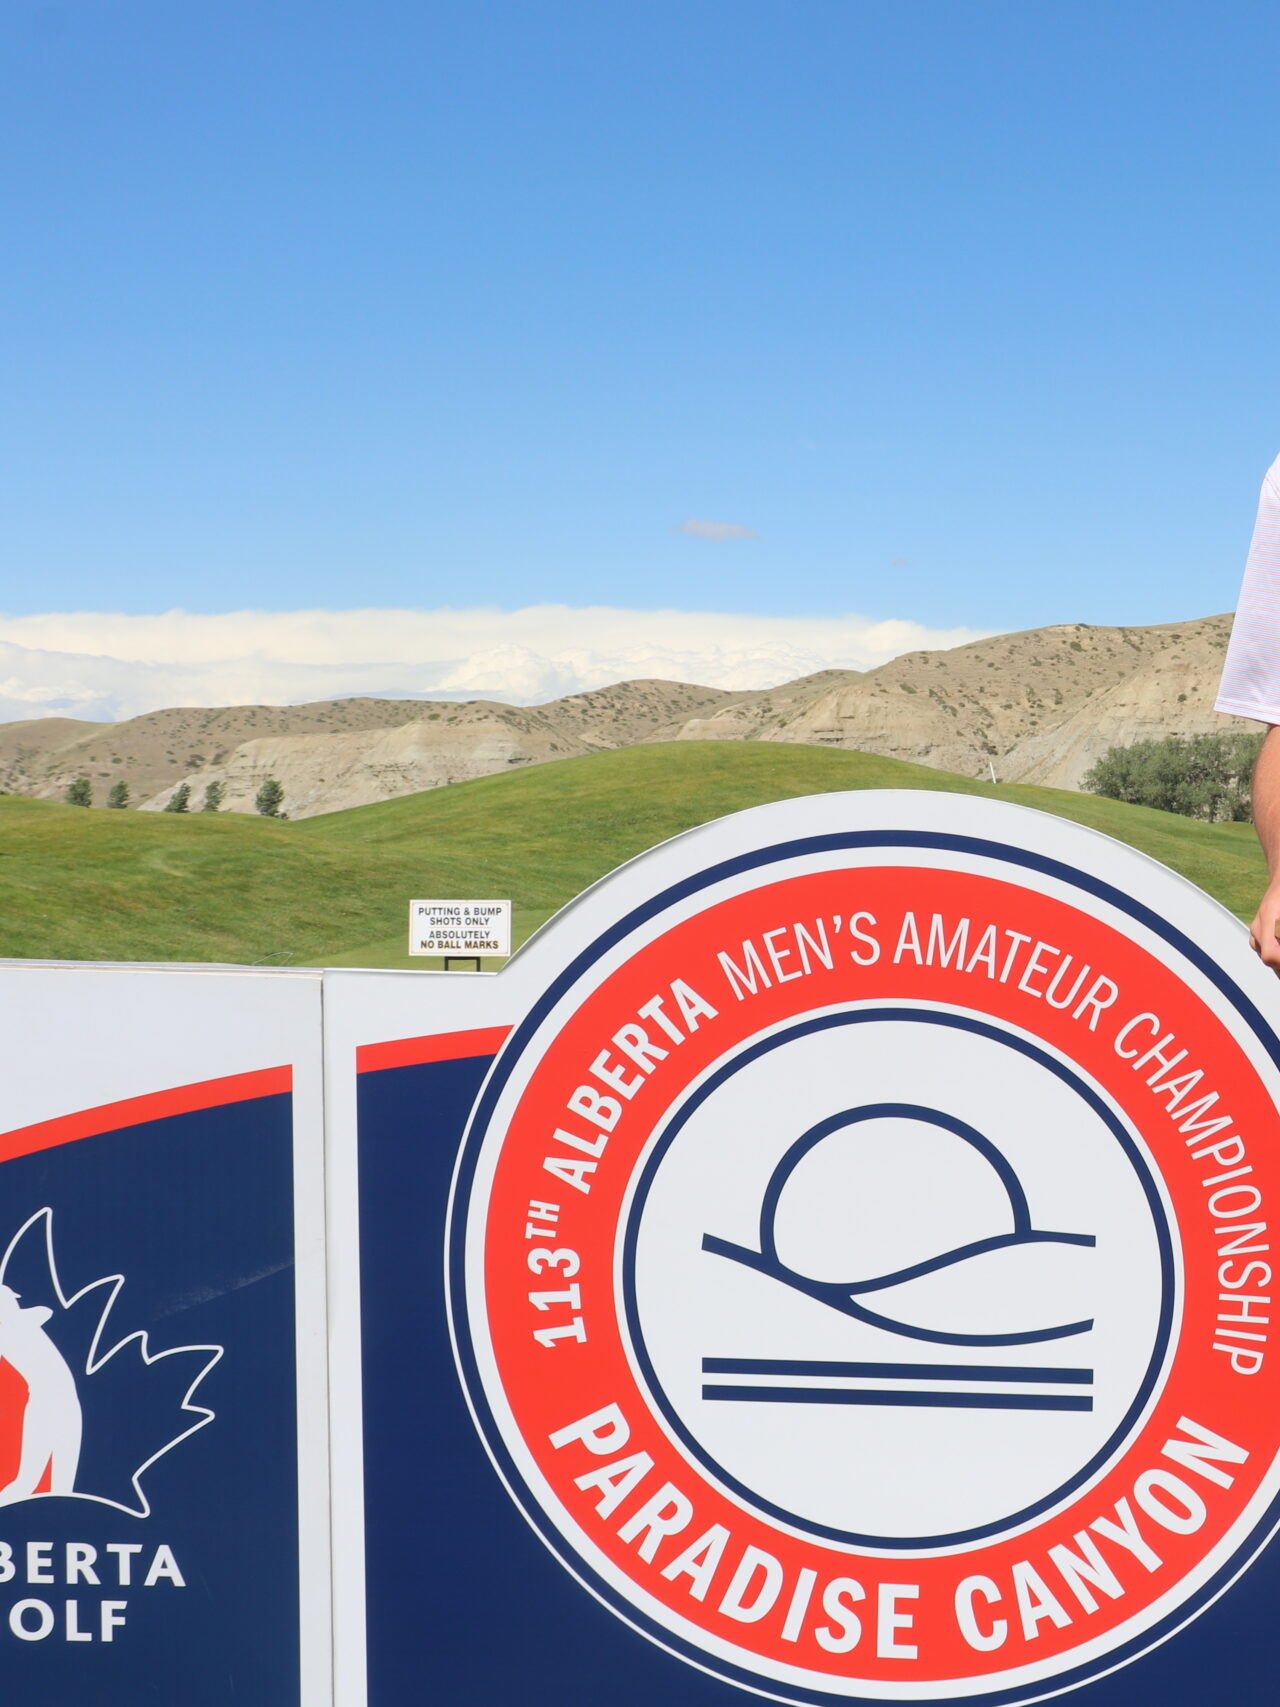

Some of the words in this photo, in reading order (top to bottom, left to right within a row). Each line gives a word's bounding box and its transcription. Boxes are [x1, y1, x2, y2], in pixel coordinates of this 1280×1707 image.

[418, 907, 460, 916] PUTTING
[463, 907, 470, 916] &
[474, 907, 502, 916] BUMP
[420, 940, 434, 949] NO
[437, 940, 461, 949] BALL
[464, 940, 499, 949] MARKS
[429, 930, 490, 939] ABSOLUTELY
[430, 917, 462, 926] SHOTS
[465, 917, 490, 926] ONLY
[717, 912, 880, 1000] MEN'S
[893, 912, 1118, 1031] AMATEUR
[543, 979, 719, 1194] ALBERTA
[1114, 1013, 1272, 1375] CHAMPIONSHIP
[526, 1200, 587, 1347] 113TH
[549, 1403, 919, 1659] PARADISE
[955, 1416, 1250, 1651] CANYON
